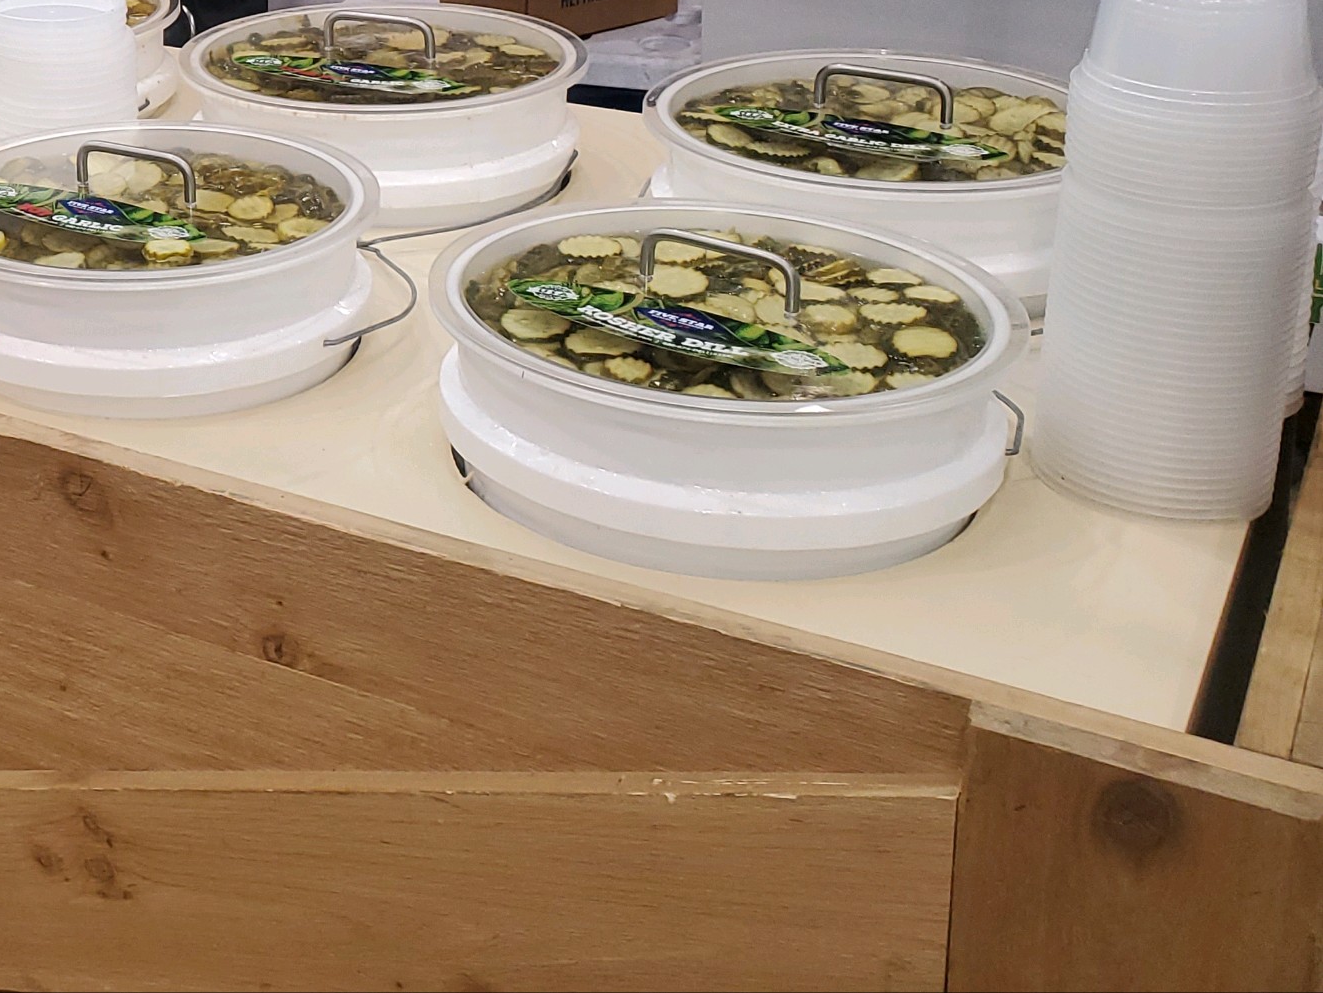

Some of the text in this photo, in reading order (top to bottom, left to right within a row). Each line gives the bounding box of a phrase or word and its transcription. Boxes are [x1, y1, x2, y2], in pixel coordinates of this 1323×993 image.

[51, 214, 124, 231] GARLIC
[576, 305, 677, 343] KOSHER
[680, 336, 750, 356] DILL
[647, 309, 716, 331] FIVE STAR
